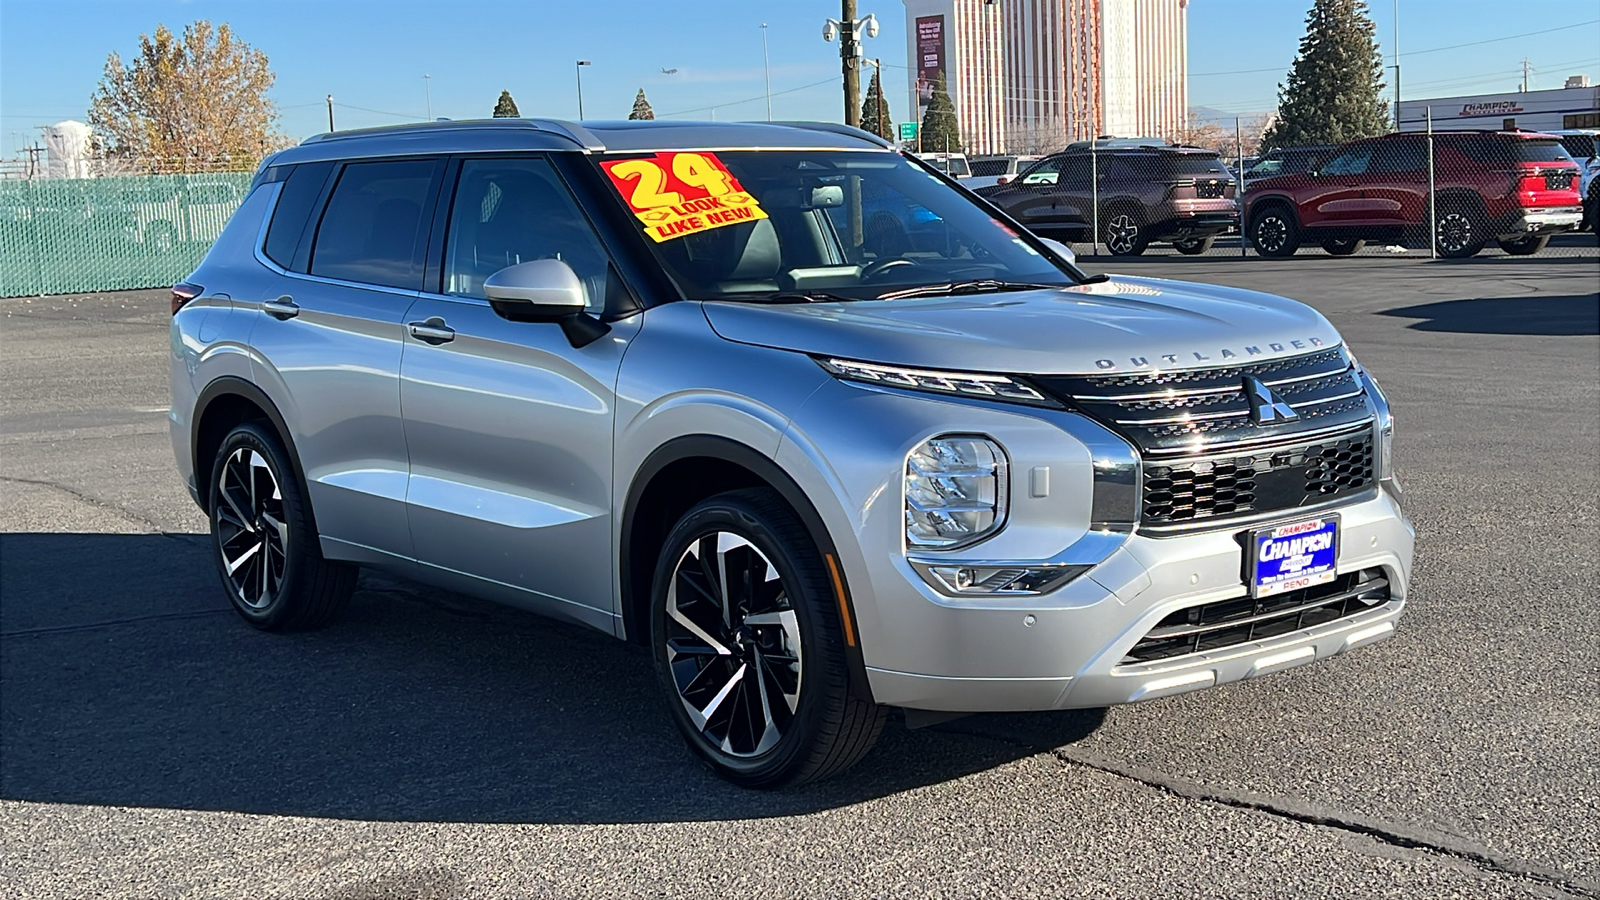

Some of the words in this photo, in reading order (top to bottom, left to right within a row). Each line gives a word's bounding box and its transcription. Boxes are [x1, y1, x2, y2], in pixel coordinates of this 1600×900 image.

[1463, 101, 1517, 112] CHAMPION
[610, 153, 736, 209] 24
[670, 197, 726, 217] LOOK
[656, 217, 703, 238] LIKE
[706, 207, 751, 225] NEW
[1095, 337, 1324, 370] OUTLANDER
[1278, 521, 1318, 536] CHAMPION
[1260, 532, 1332, 562] CHAMPION
[1283, 578, 1309, 590] RENO
